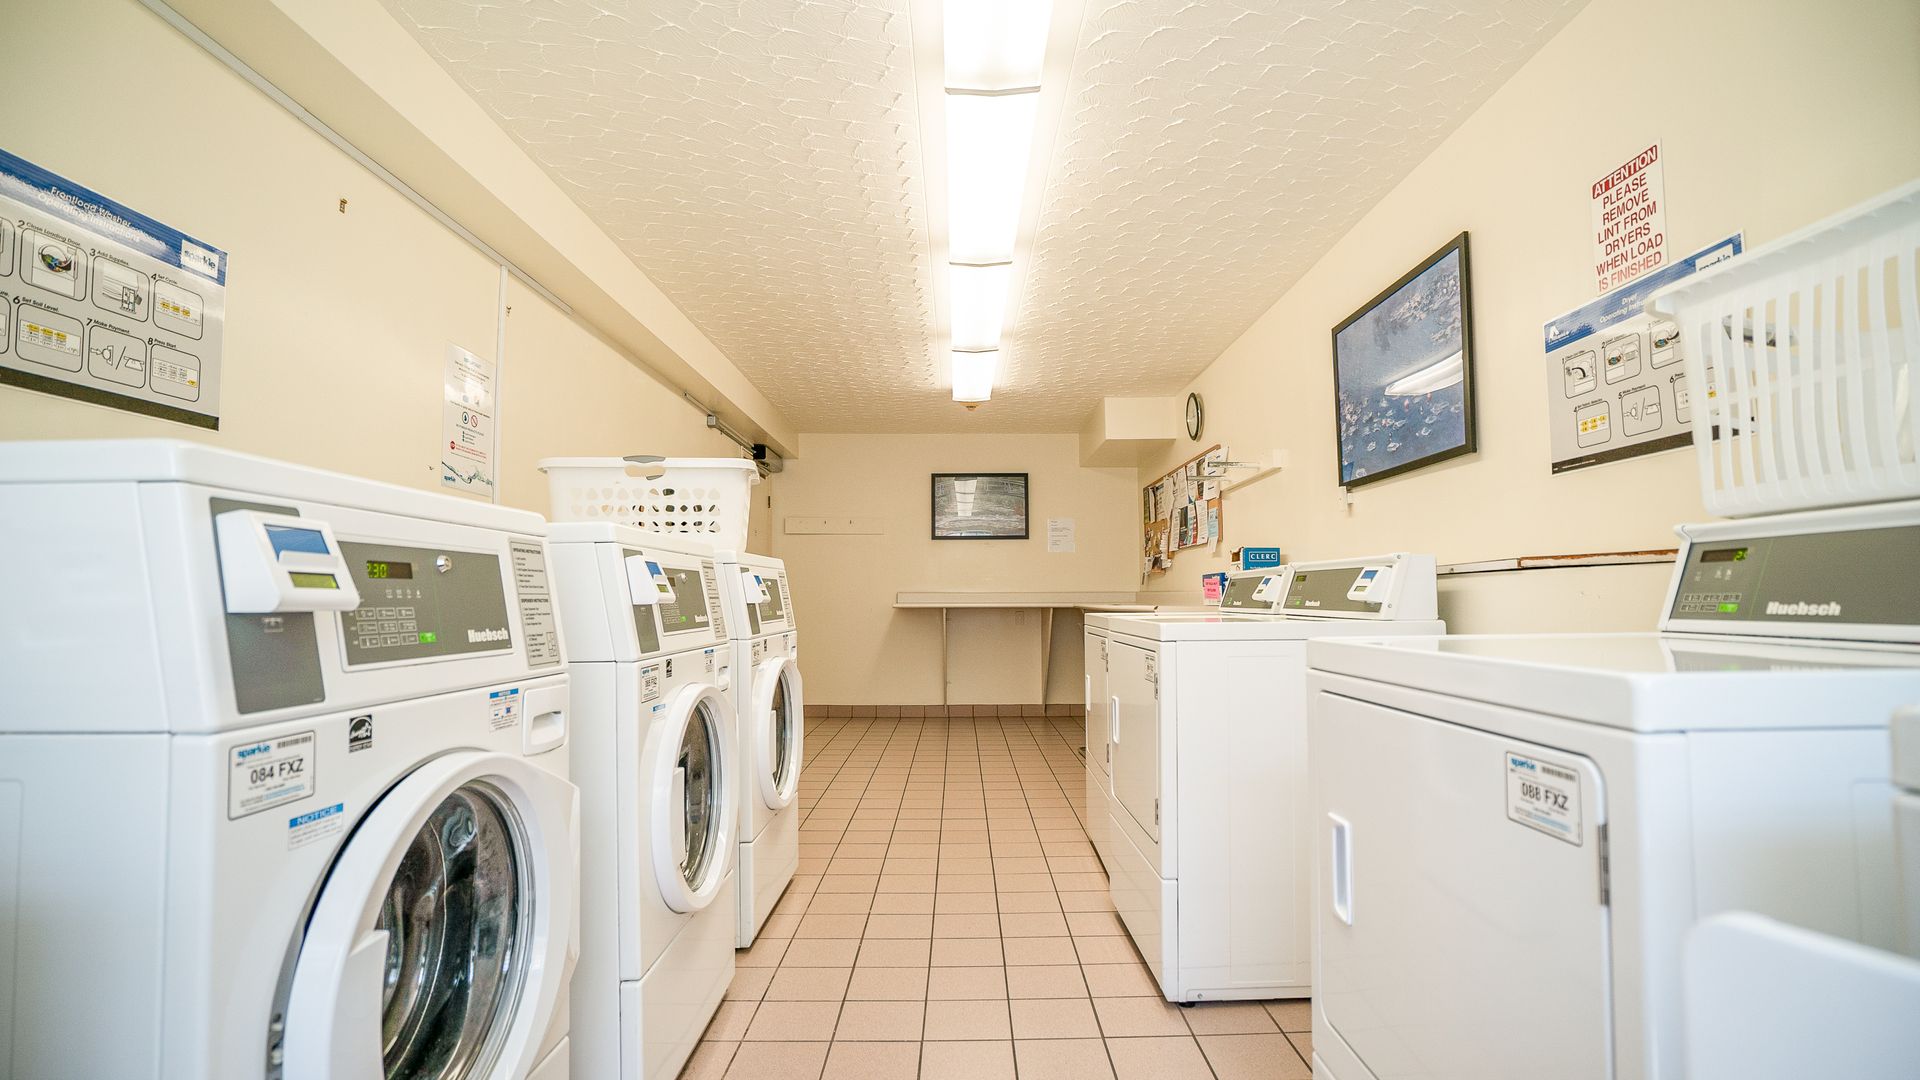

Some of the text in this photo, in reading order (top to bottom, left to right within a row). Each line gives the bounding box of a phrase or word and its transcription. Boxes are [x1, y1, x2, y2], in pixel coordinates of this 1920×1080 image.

[1593, 146, 1657, 198] ATTENTION
[51, 186, 97, 211] Frontload
[1603, 172, 1647, 209] PLEASE
[1602, 188, 1649, 226] REMOVE
[18, 220, 25, 229] 2
[1597, 200, 1657, 245] LINT FROM
[1605, 222, 1651, 256] DRYERS
[89, 249, 96, 257] 3
[1596, 233, 1663, 277] WHEN LOAD
[1598, 251, 1662, 292] IS FINISHED
[13, 295, 20, 305] 6
[86, 318, 93, 326] 7
[147, 337, 154, 346] 8
[1766, 601, 1841, 617] Huebsch
[467, 628, 509, 643] Huebsch
[250, 758, 304, 784] 084 FXZ
[1522, 782, 1569, 811] 088 FXZ
[297, 806, 338, 826] NOTICE
